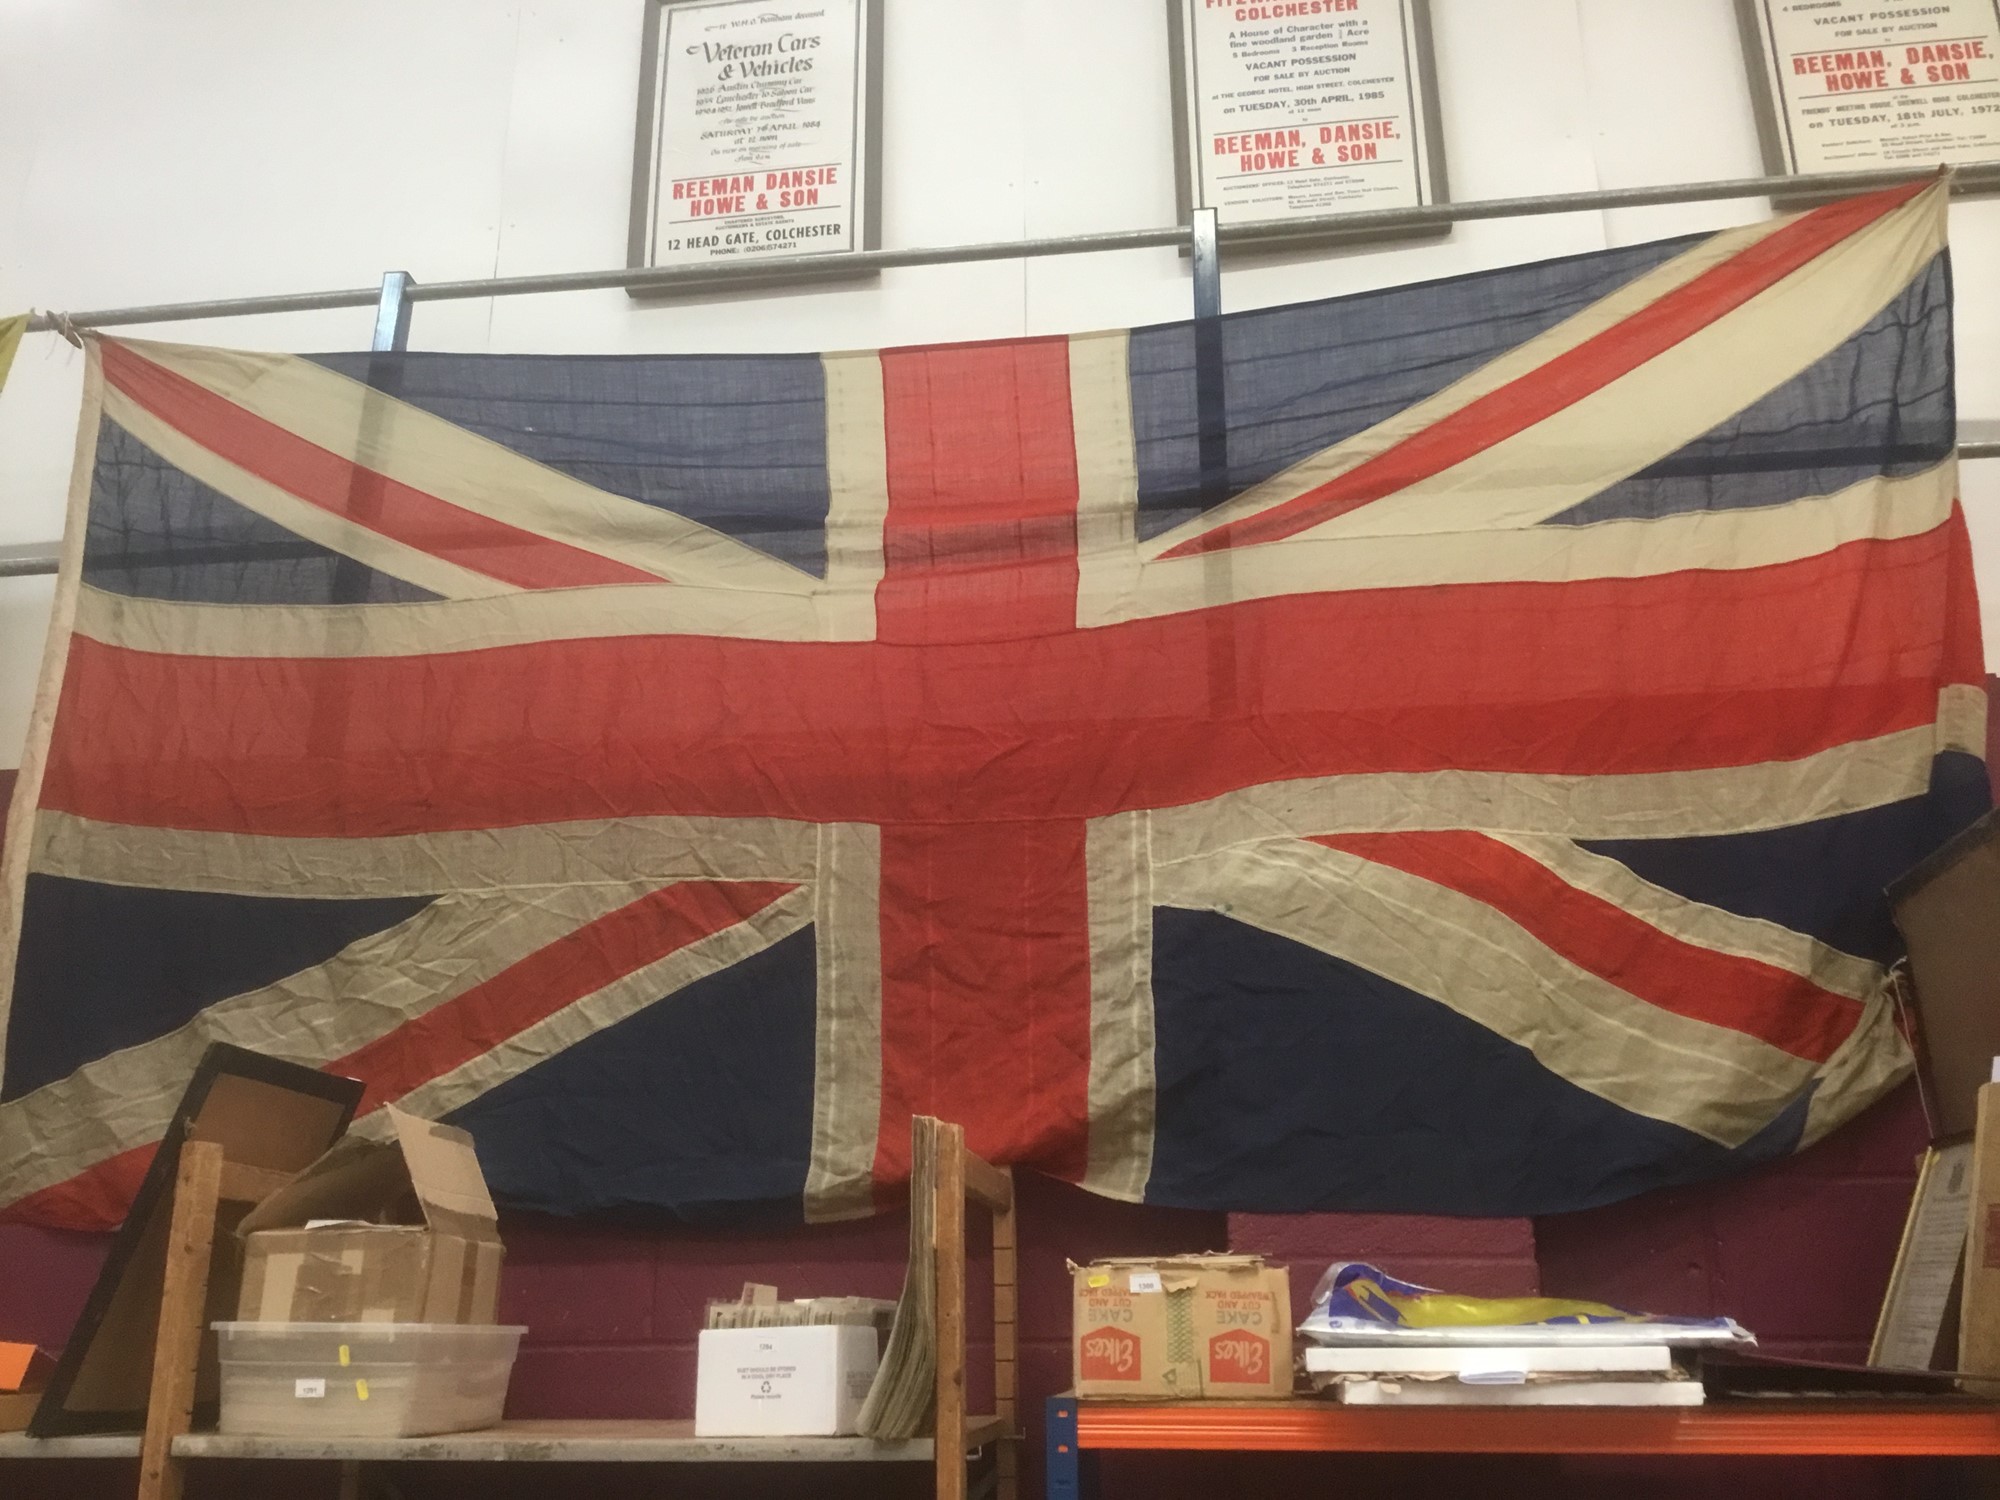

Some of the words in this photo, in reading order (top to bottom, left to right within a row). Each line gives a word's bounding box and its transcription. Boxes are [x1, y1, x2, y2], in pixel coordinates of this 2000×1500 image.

[1235, 0, 1359, 22] COLCHESTER
[1792, 1, 1842, 12] BEDROOMS
[1814, 14, 1864, 26] VACANT
[1870, 5, 1951, 21] POSSESSION
[1240, 29, 1270, 38] House
[1273, 27, 1283, 36] of
[1286, 22, 1334, 34] Character
[1337, 19, 1359, 29] with
[1835, 30, 1852, 38] FOR
[1856, 27, 1878, 36] SALE
[1898, 23, 1938, 32] AUCTION
[1229, 40, 1247, 49] fine
[1251, 35, 1296, 47] woodland
[1299, 32, 1333, 43] garden
[1347, 28, 1370, 37] Acre
[686, 40, 772, 64] Veteran
[777, 33, 821, 54] Cars
[1241, 48, 1280, 58] Bedrooms
[1300, 42, 1339, 53] Reception
[1342, 39, 1369, 48] Rooms
[1793, 50, 1892, 75] REEMAN,
[1906, 41, 1994, 65] DANSIE,
[718, 64, 735, 81] &
[740, 55, 813, 78] Vehicles
[1245, 59, 1287, 71] VACANT
[1291, 53, 1357, 67] POSSESSION
[1253, 75, 1270, 83] FOR
[1274, 72, 1294, 81] SALE
[1298, 70, 1310, 78] BY
[1313, 67, 1350, 77] AUCTION
[1825, 70, 1889, 92] HOWE
[1900, 67, 1916, 85] &
[1926, 62, 1970, 83] SON
[718, 82, 748, 93] Austin
[788, 77, 802, 85] Car
[799, 86, 814, 94] Car
[1237, 89, 1266, 98] GEORGE
[1296, 84, 1314, 92] HIGH
[1347, 76, 1395, 86] COLCHESTER
[1223, 107, 1236, 115] on
[1239, 100, 1290, 113] TUESDAY,
[1294, 97, 1317, 107] 30th
[1321, 94, 1354, 105] APRIL,
[1358, 91, 1385, 101] 1985
[1836, 103, 1866, 113] MEETING
[1809, 121, 1823, 129] on
[1829, 114, 1891, 127] TUESDAY,
[1897, 111, 1925, 121] 18th
[1931, 107, 1964, 118] JULY,
[1971, 104, 2000, 115] 1972
[700, 128, 753, 141] SATURDAY
[769, 122, 797, 132] APRIL
[1214, 129, 1306, 155] REEMAN,
[1320, 121, 1401, 144] DANSIE,
[1240, 150, 1300, 172] HOWE
[1312, 147, 1326, 165] &
[1338, 143, 1378, 161] SON
[672, 175, 755, 201] REEMAN
[766, 167, 838, 191] DANSIE
[690, 195, 746, 217] HOWE
[756, 193, 769, 211] &
[779, 188, 819, 208] SON
[667, 238, 681, 251] 12
[687, 234, 719, 249] HEAD
[725, 230, 759, 246] GATE,
[765, 223, 841, 242] COLCHESTER
[710, 247, 740, 257] PHONE:
[1088, 1298, 1109, 1308] AND
[1113, 1298, 1132, 1308] CUT
[1205, 1291, 1227, 1300] PACK
[1217, 1300, 1239, 1310] AND
[1242, 1301, 1261, 1310] CUT
[1088, 1308, 1133, 1323] CAKE
[1216, 1309, 1263, 1325] CAKE
[1086, 1338, 1134, 1373] Elkes
[1214, 1340, 1263, 1375] Elkes
